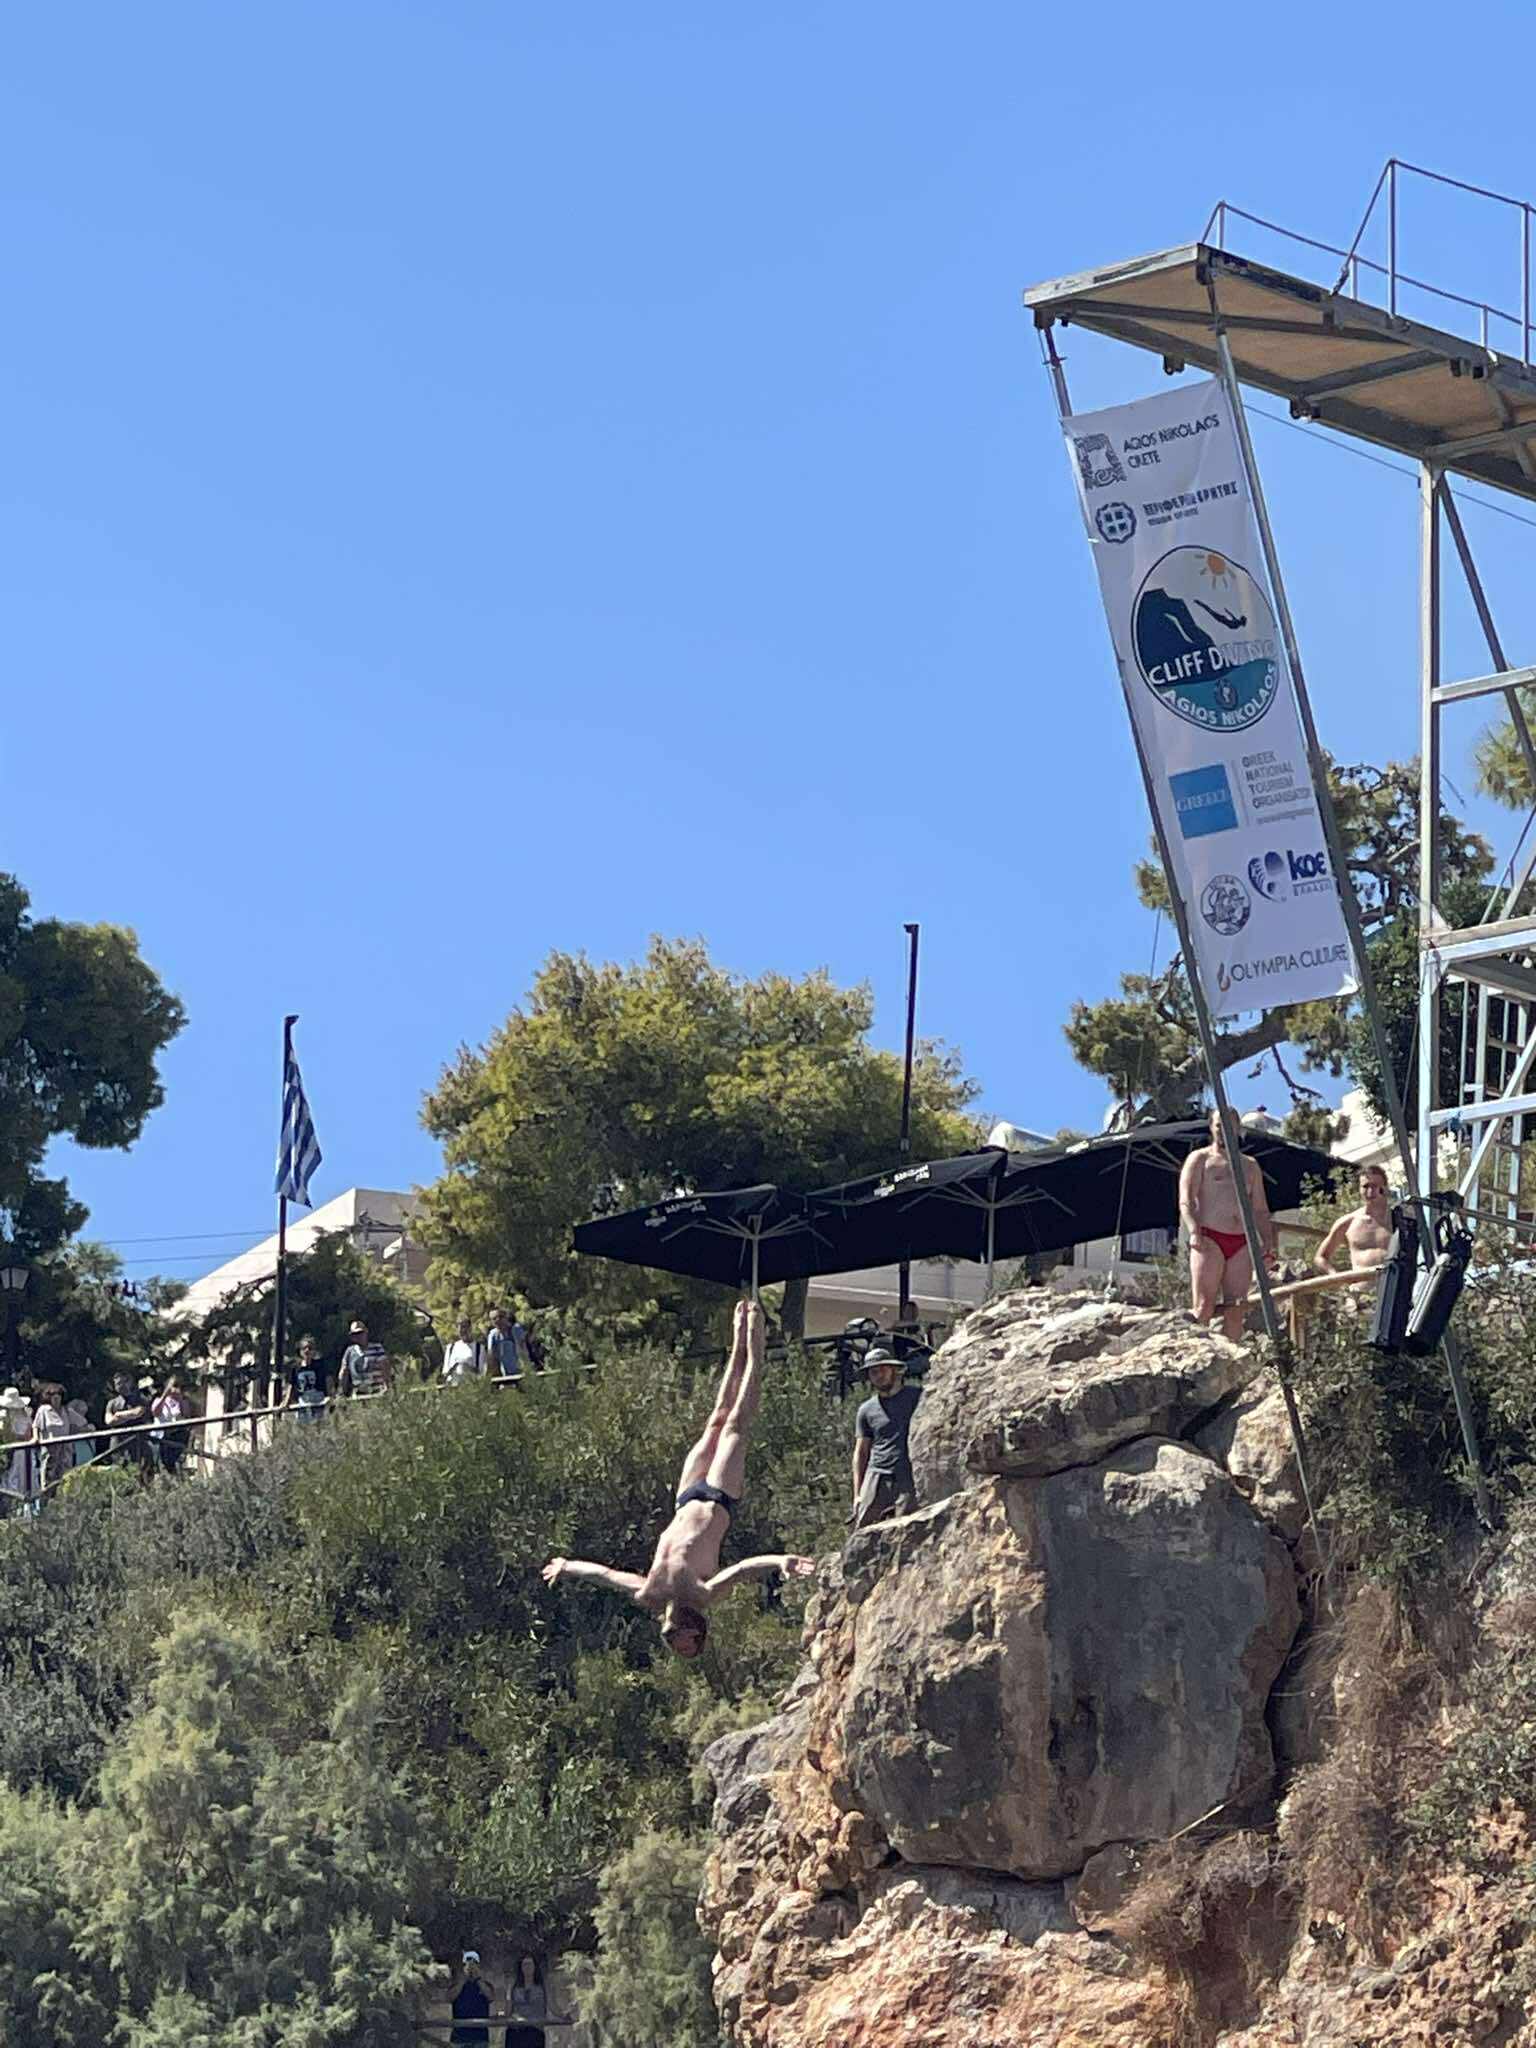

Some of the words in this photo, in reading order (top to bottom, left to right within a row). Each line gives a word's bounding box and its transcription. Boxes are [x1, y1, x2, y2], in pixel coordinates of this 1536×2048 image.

[1160, 414, 1220, 444] NIKOLAOS
[1128, 450, 1161, 469] CRETE
[1149, 650, 1204, 685] CLIFF
[1161, 689, 1218, 725] AGIOS
[1241, 751, 1278, 768] GREEK
[1244, 760, 1295, 782] NATIONAL
[1230, 953, 1300, 982] OLYMPIA
